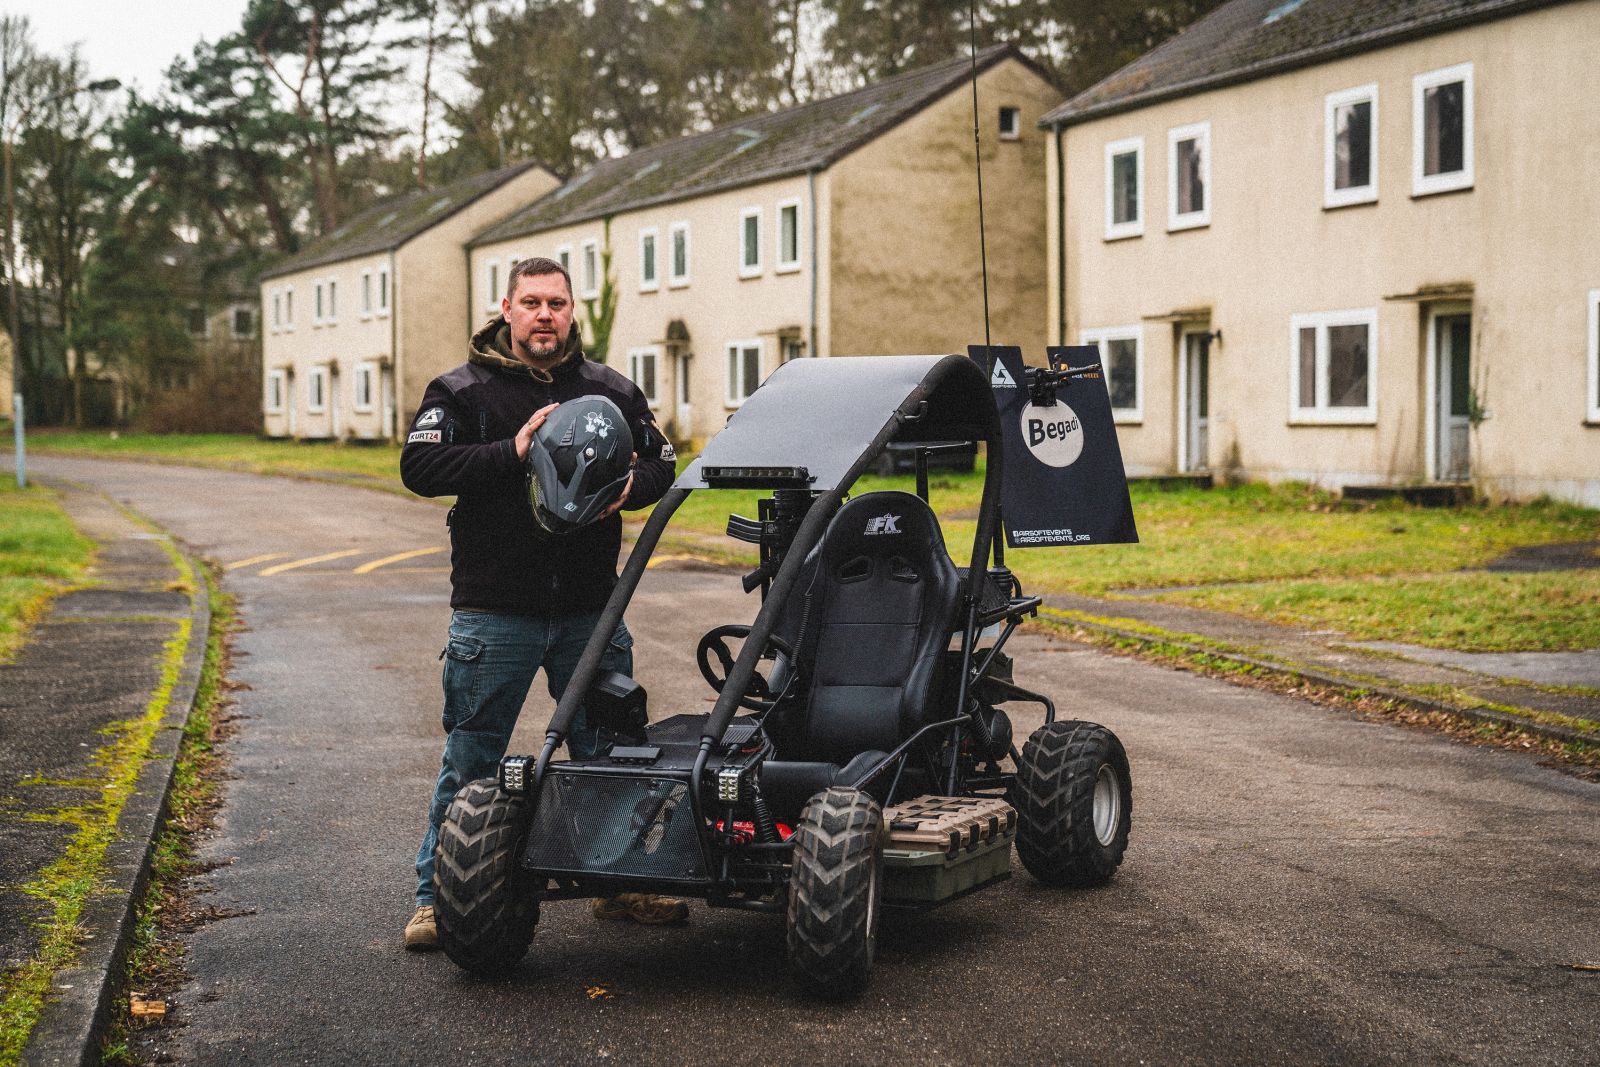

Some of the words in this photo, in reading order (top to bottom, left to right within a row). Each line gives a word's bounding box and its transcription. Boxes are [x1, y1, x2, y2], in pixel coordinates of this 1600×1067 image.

[410, 432, 439, 441] KURT24
[1028, 416, 1079, 448] Begadi
[1018, 529, 1072, 537] AIRSOFTEVENTS
